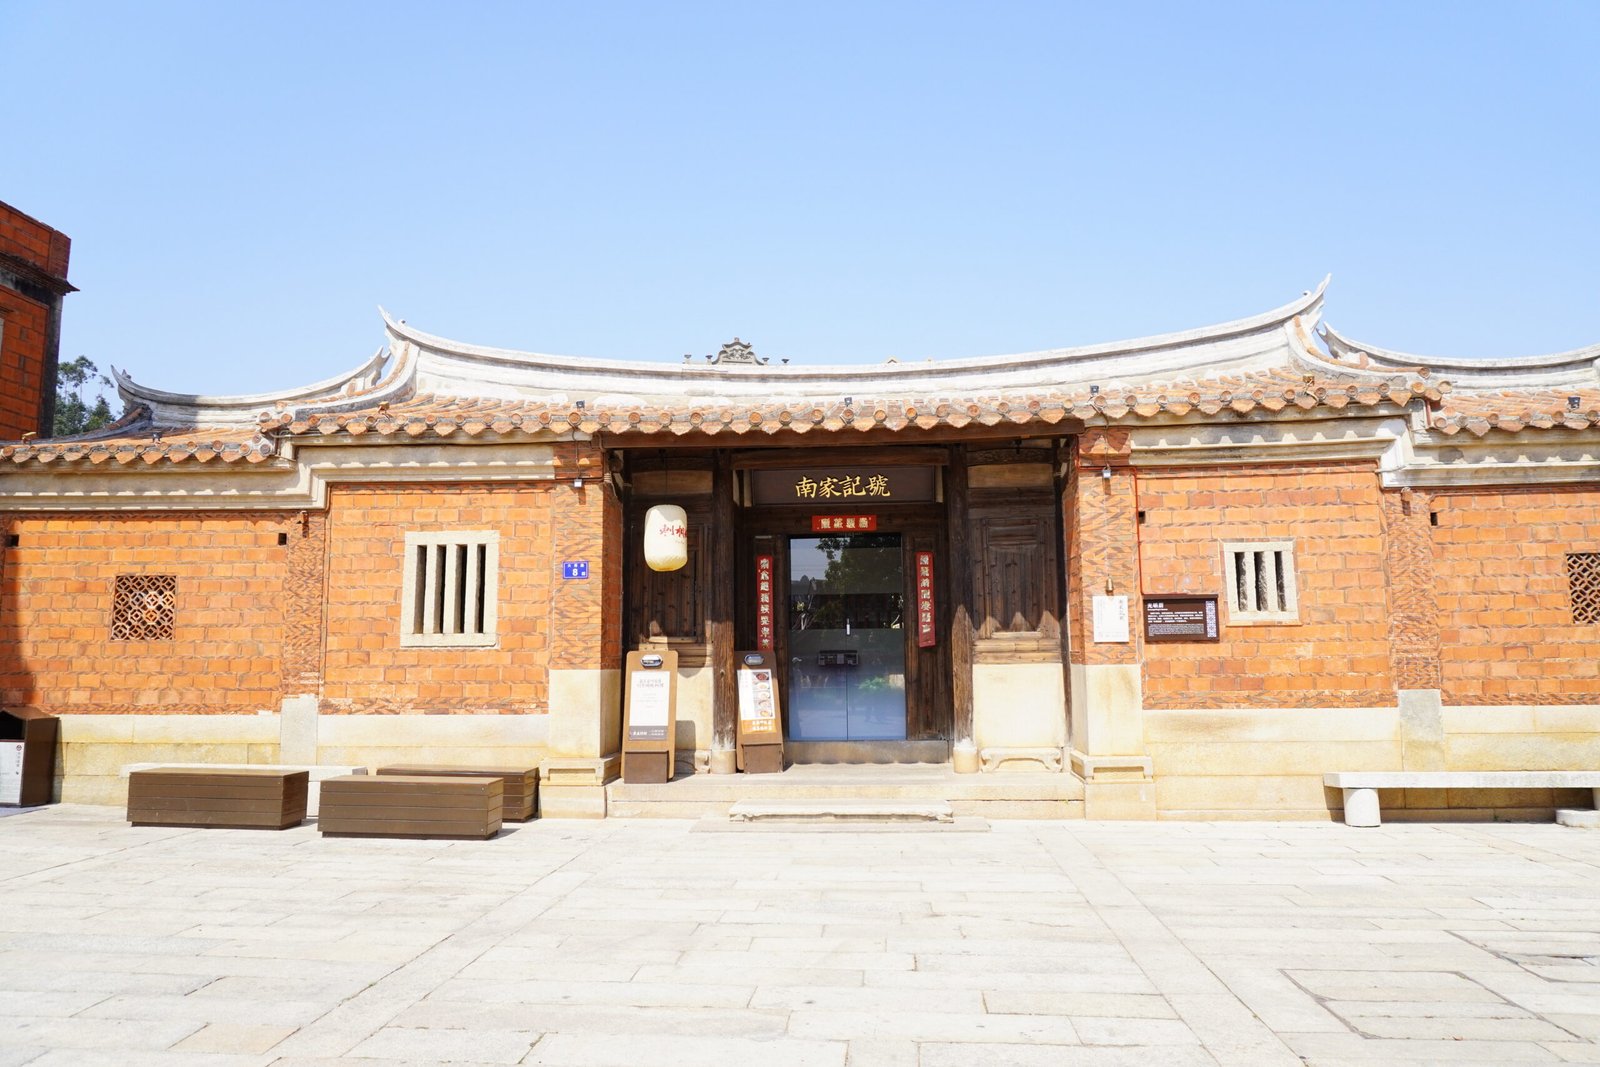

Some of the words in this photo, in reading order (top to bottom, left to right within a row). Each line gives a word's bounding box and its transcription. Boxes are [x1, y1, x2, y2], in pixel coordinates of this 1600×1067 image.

[795, 474, 891, 498] 南家記號
[572, 568, 578, 577] 8
